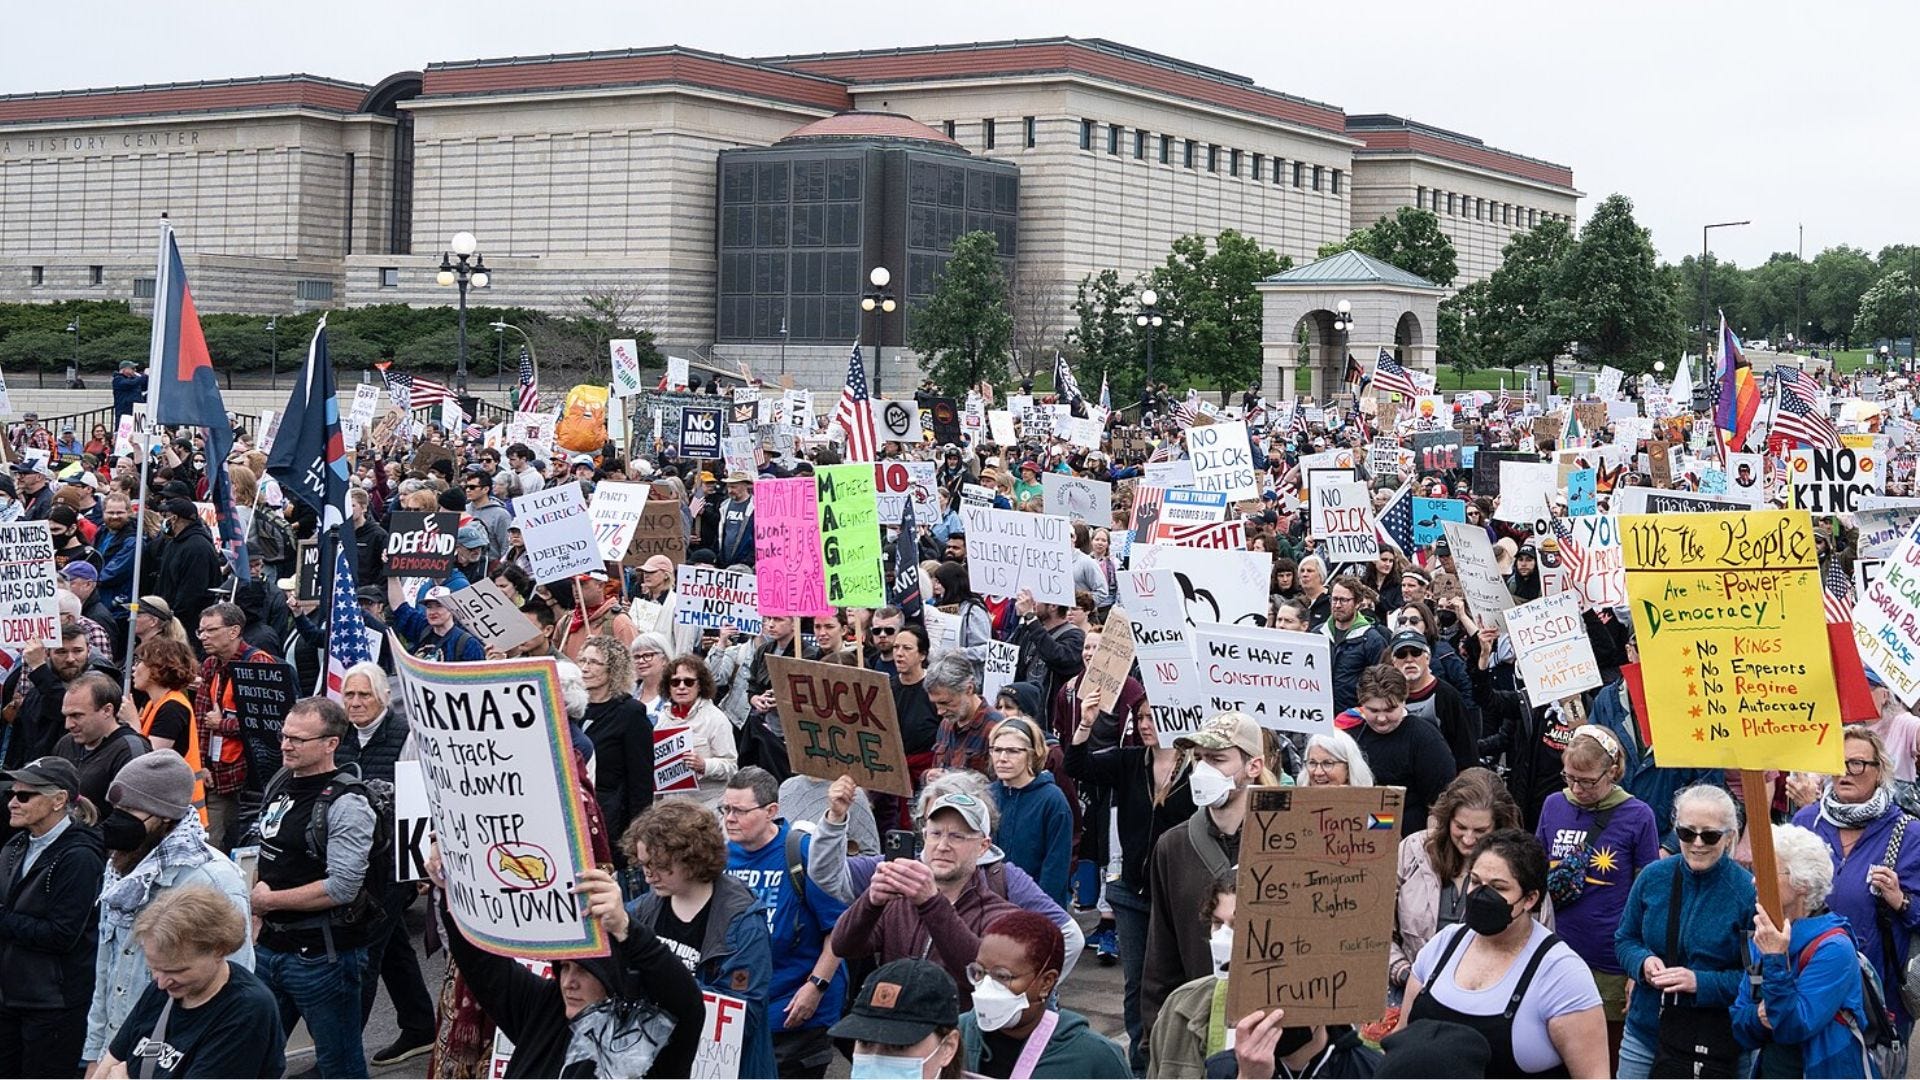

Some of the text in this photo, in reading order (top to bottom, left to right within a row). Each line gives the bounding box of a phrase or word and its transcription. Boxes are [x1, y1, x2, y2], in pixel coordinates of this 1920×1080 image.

[28, 136, 107, 152] HISTORY
[123, 131, 201, 147] CENTER
[614, 345, 637, 371] Resist
[617, 370, 637, 390] SING
[687, 413, 715, 431] NO
[684, 431, 717, 446] KINGS
[1112, 429, 1144, 440] SILENCE
[1122, 440, 1133, 448] IS
[1192, 428, 1217, 449] NO
[1194, 447, 1249, 472] DICK-
[1422, 443, 1459, 470] ICE
[1814, 449, 1857, 482] NO
[818, 471, 870, 502] MOTHERS
[1197, 470, 1255, 492] TATERS
[521, 491, 569, 513] I LOVE
[600, 490, 630, 502] PARTY
[756, 480, 816, 521] HATE
[1321, 488, 1342, 507] NO
[524, 503, 587, 530] AMERICA
[595, 510, 620, 519] LIKE
[643, 514, 675, 529] NO
[822, 504, 873, 532] AGAINST
[966, 508, 992, 533] YOU
[1034, 516, 1065, 542] NOT
[1168, 508, 1217, 521] BECOMES LAW
[1323, 507, 1373, 533] DICK
[19, 524, 48, 543] NEEDS
[594, 523, 627, 547] 1776
[1327, 534, 1377, 555] TATORS
[1418, 533, 1433, 544] NO
[1630, 520, 1671, 568] We
[15, 543, 52, 561] PROCESS
[533, 540, 588, 562] DEFEND
[635, 537, 684, 553] KINGS
[784, 525, 821, 579] US
[823, 536, 865, 568] GIANT
[391, 557, 450, 571] DEMOCRACY
[557, 553, 571, 562] THE
[1, 561, 48, 581] WHEN ICE
[693, 569, 744, 588] FIGHT
[984, 566, 1007, 587] US
[1, 579, 55, 600] HAS GUNS
[757, 566, 827, 613] GREAT
[1038, 572, 1062, 596] US
[1131, 572, 1156, 593] NO
[1664, 572, 1808, 601] Are the Power of
[681, 582, 758, 607] IGNORANCE
[1869, 581, 1903, 623] SARAH
[11, 602, 41, 616] AND A
[702, 601, 735, 616] NOT
[1144, 607, 1158, 618] to
[1507, 592, 1572, 622] WE The People
[1535, 610, 1550, 622] ARE
[1518, 615, 1577, 648] PISSED
[1854, 621, 1880, 656] FROM
[988, 642, 1015, 662] KING
[1209, 641, 1315, 670] WE HAVE A
[1532, 643, 1574, 664] Orange
[1696, 640, 1718, 656] No
[1878, 623, 1916, 667] HOUSE
[234, 667, 283, 682] THE FLAG
[986, 659, 1011, 674] SINCE
[1155, 663, 1179, 682] NO
[1539, 661, 1596, 690] MATTER!
[1701, 658, 1807, 679] No Emperors
[238, 683, 286, 702] PROTECTS
[1703, 676, 1798, 698] No Regime
[246, 702, 281, 717] US ALL
[787, 673, 887, 732] FUCK
[1210, 696, 1325, 722] NOT A KING
[1707, 696, 1816, 721] No Autocracy
[244, 715, 259, 729] OR
[1151, 704, 1203, 733] TRUMP
[677, 733, 685, 749] IS
[1710, 715, 1830, 745] No Plutocracy
[448, 736, 514, 766] track
[460, 767, 525, 797] down
[449, 809, 468, 848] by
[476, 813, 525, 848] STEP
[1255, 807, 1363, 852] Yes to Trans
[1323, 833, 1376, 865] Rights
[763, 870, 784, 888] TO
[1250, 864, 1289, 900] Yes
[480, 881, 579, 928] to TOWN
[1311, 891, 1358, 918] Rights
[1246, 918, 1312, 960] No to
[1251, 962, 1348, 1010] Trump
